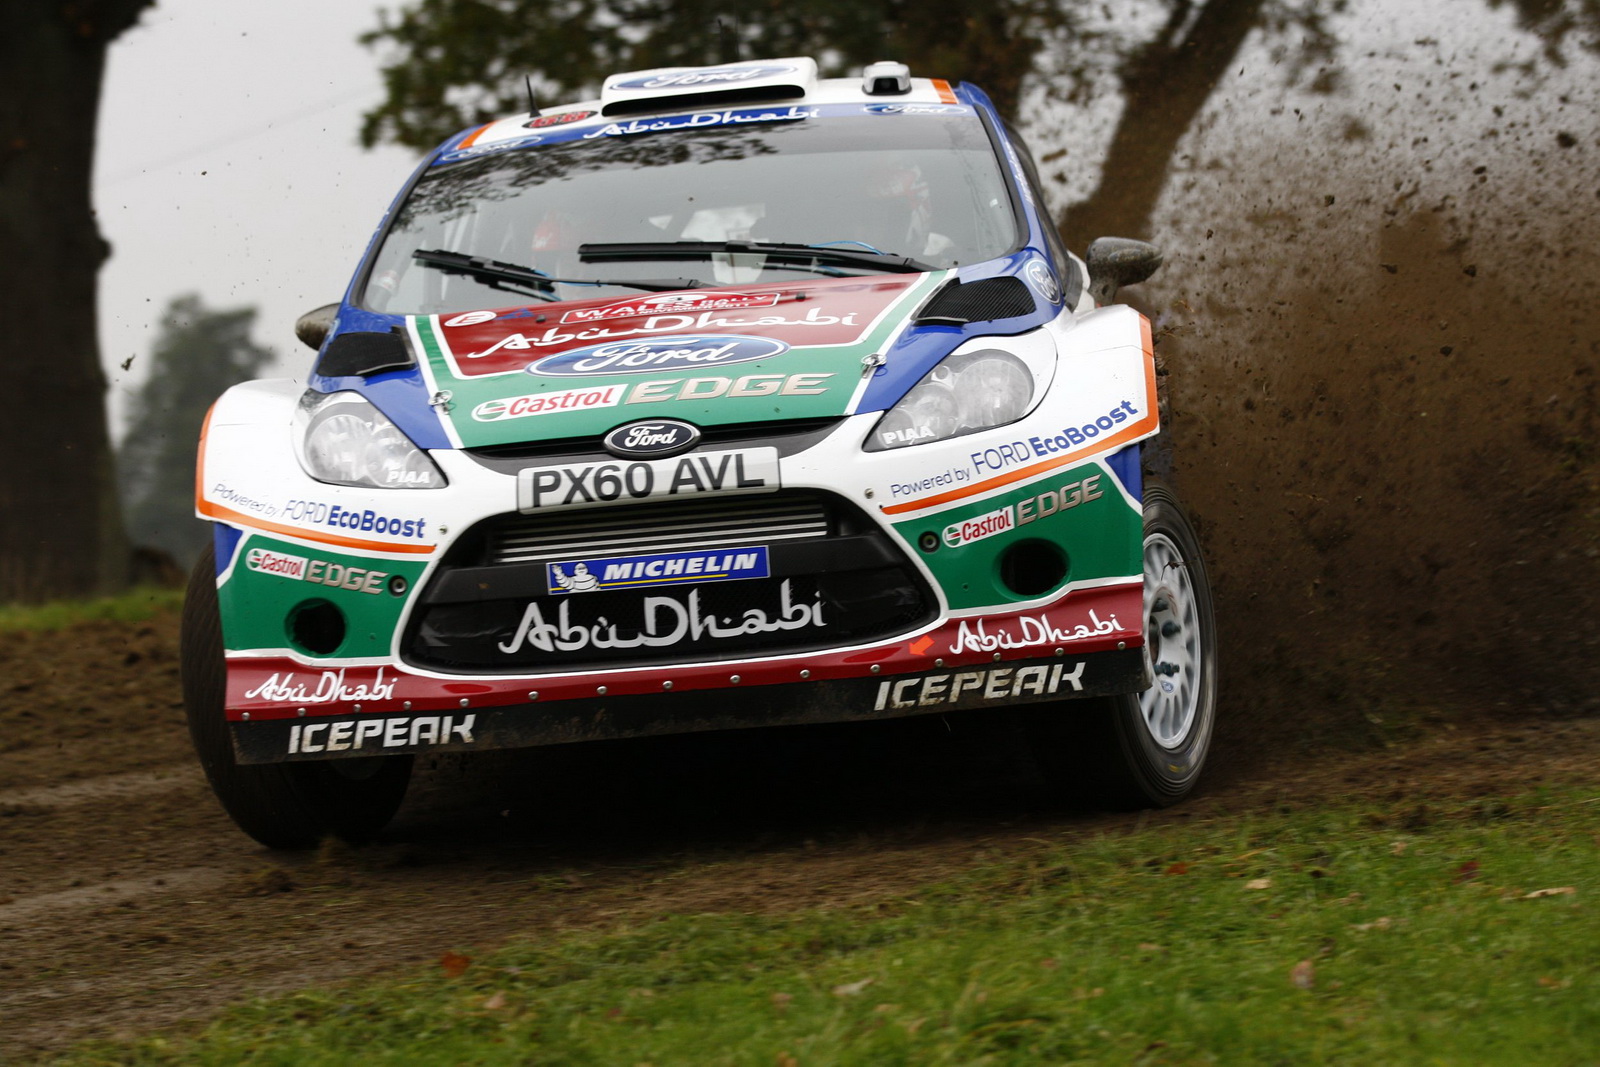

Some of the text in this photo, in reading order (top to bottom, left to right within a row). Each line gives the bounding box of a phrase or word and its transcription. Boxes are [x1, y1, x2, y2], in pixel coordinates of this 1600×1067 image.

[644, 68, 763, 88] Ford
[687, 106, 820, 127] Dhabi
[575, 301, 694, 318] WALES
[634, 307, 858, 333] Dhabi
[573, 339, 740, 372] Ford
[509, 373, 838, 415] Castrol EDGE
[624, 425, 677, 448] Ford
[882, 425, 936, 445] PIAA
[890, 399, 1139, 498] Powered by FORD EcoBoost
[386, 470, 430, 484] PIAA
[532, 453, 765, 508] PX60 AVL
[212, 483, 426, 539] Powered by FORD EcoBoost
[962, 473, 1104, 541] Castrol EDGE
[260, 552, 389, 595] Castrol EDGE
[603, 553, 758, 581] MICHELIN
[643, 578, 827, 647] Dhabi
[1019, 609, 1125, 649] Dhabi
[314, 666, 398, 702] Dhabi
[874, 662, 1086, 711] ICEPEAK
[288, 714, 476, 754] ICEPEAK
